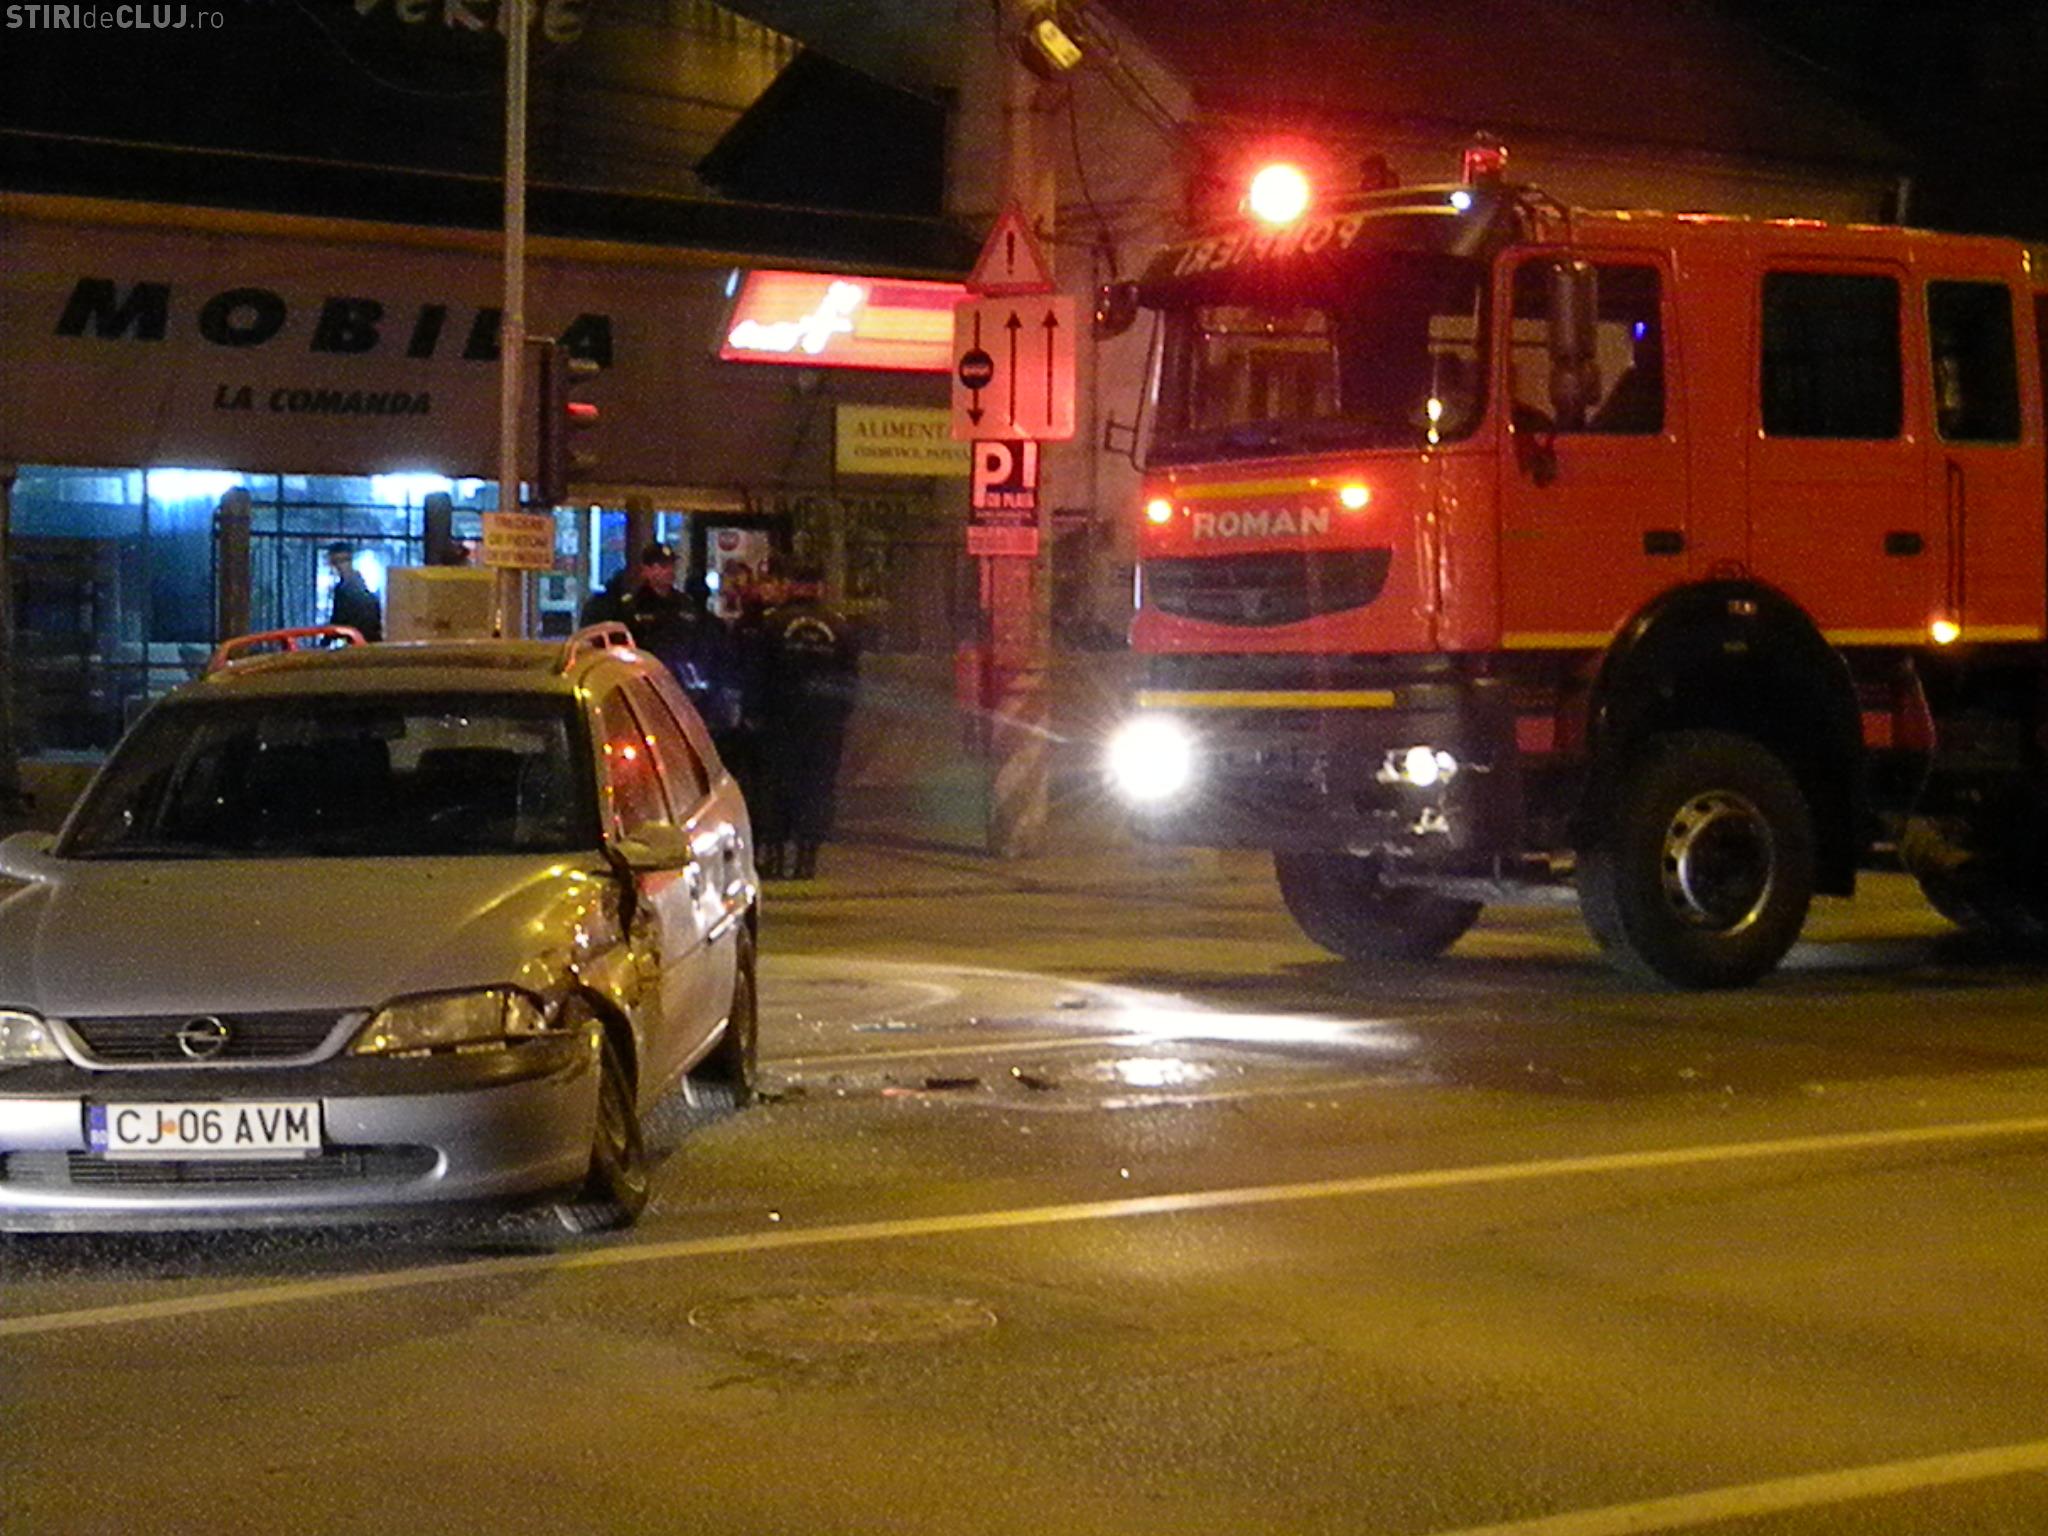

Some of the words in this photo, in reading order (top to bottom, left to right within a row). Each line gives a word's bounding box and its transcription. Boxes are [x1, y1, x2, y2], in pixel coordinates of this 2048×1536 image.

[214, 383, 253, 410] LA
[269, 387, 432, 416] COMANDA
[1193, 506, 1330, 539] ROMAN
[117, 1109, 163, 1144] CJ
[178, 1109, 223, 1143] 06
[235, 1107, 310, 1143] AVM
